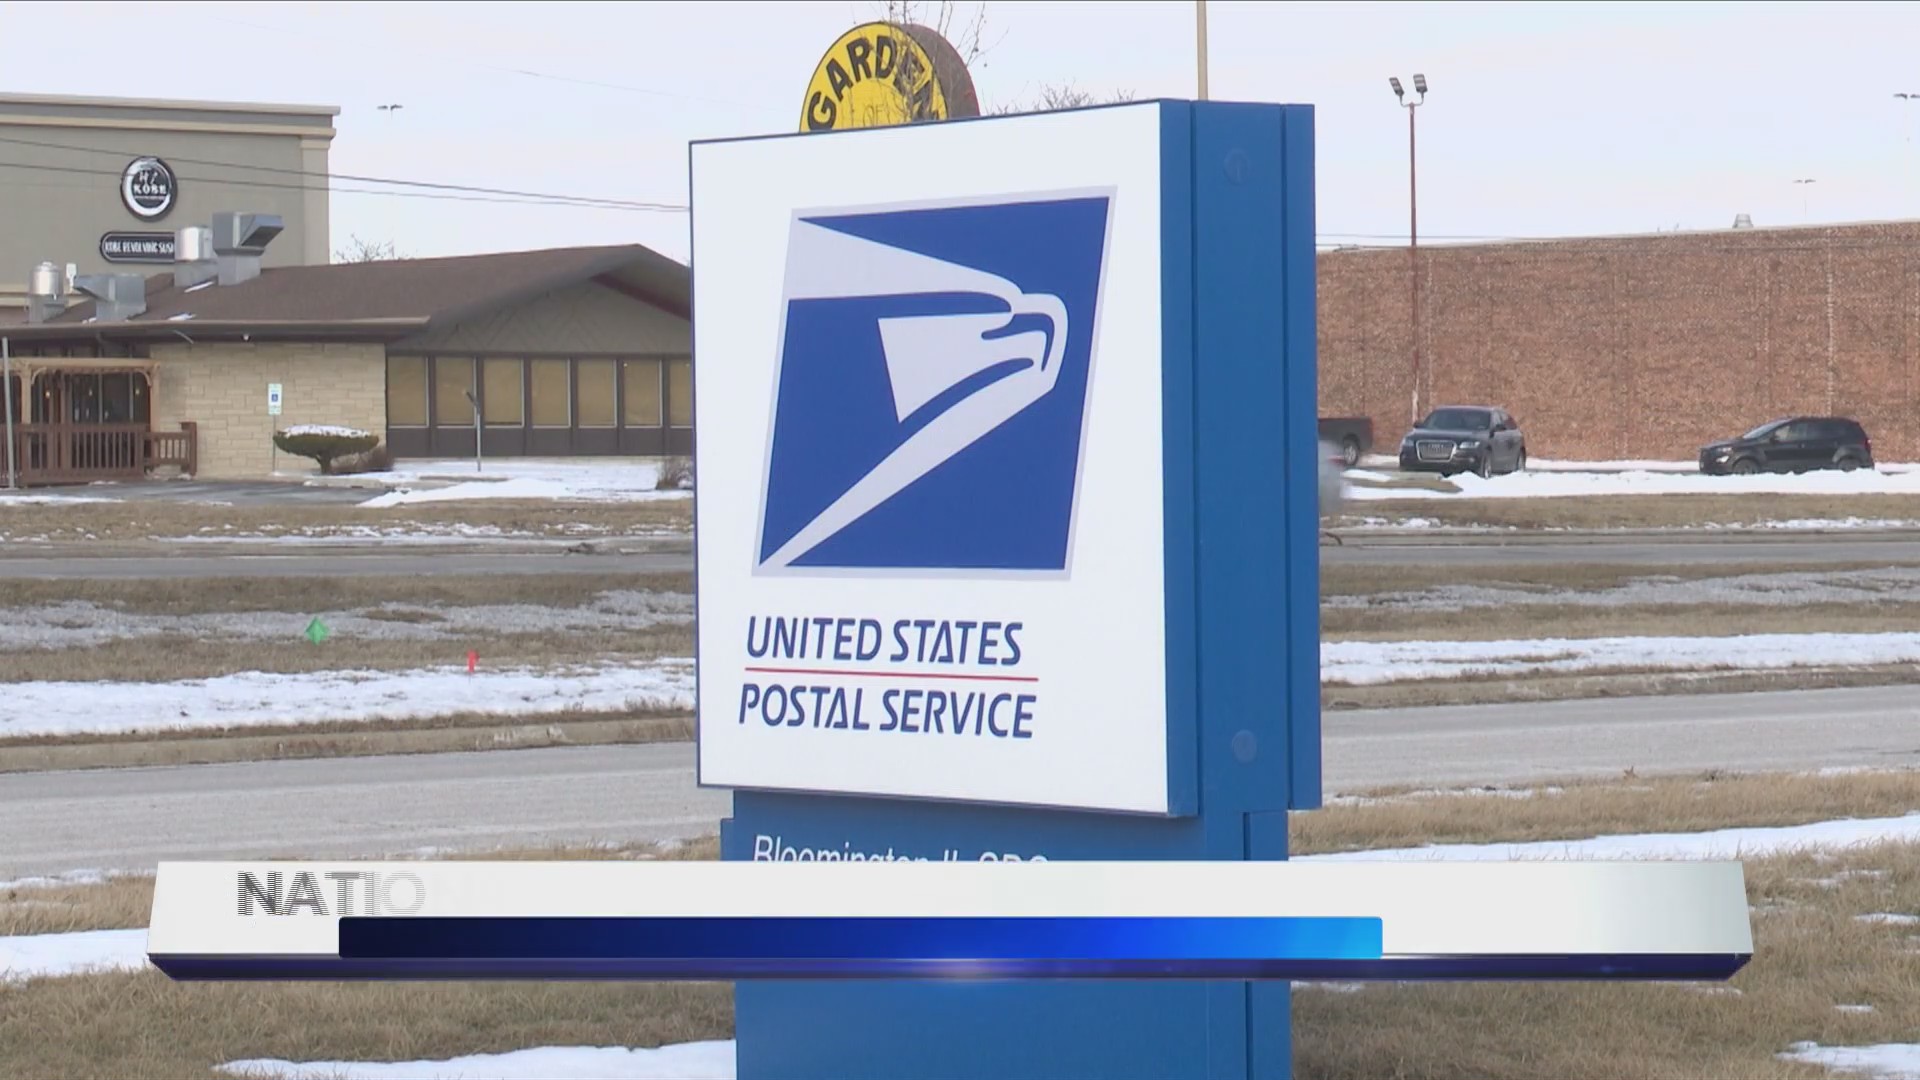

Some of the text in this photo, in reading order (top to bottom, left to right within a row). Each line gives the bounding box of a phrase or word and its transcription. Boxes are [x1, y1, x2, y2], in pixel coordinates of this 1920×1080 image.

[747, 616, 1023, 666] UNITED STATES
[739, 683, 1037, 739] POSTAL SERVICE
